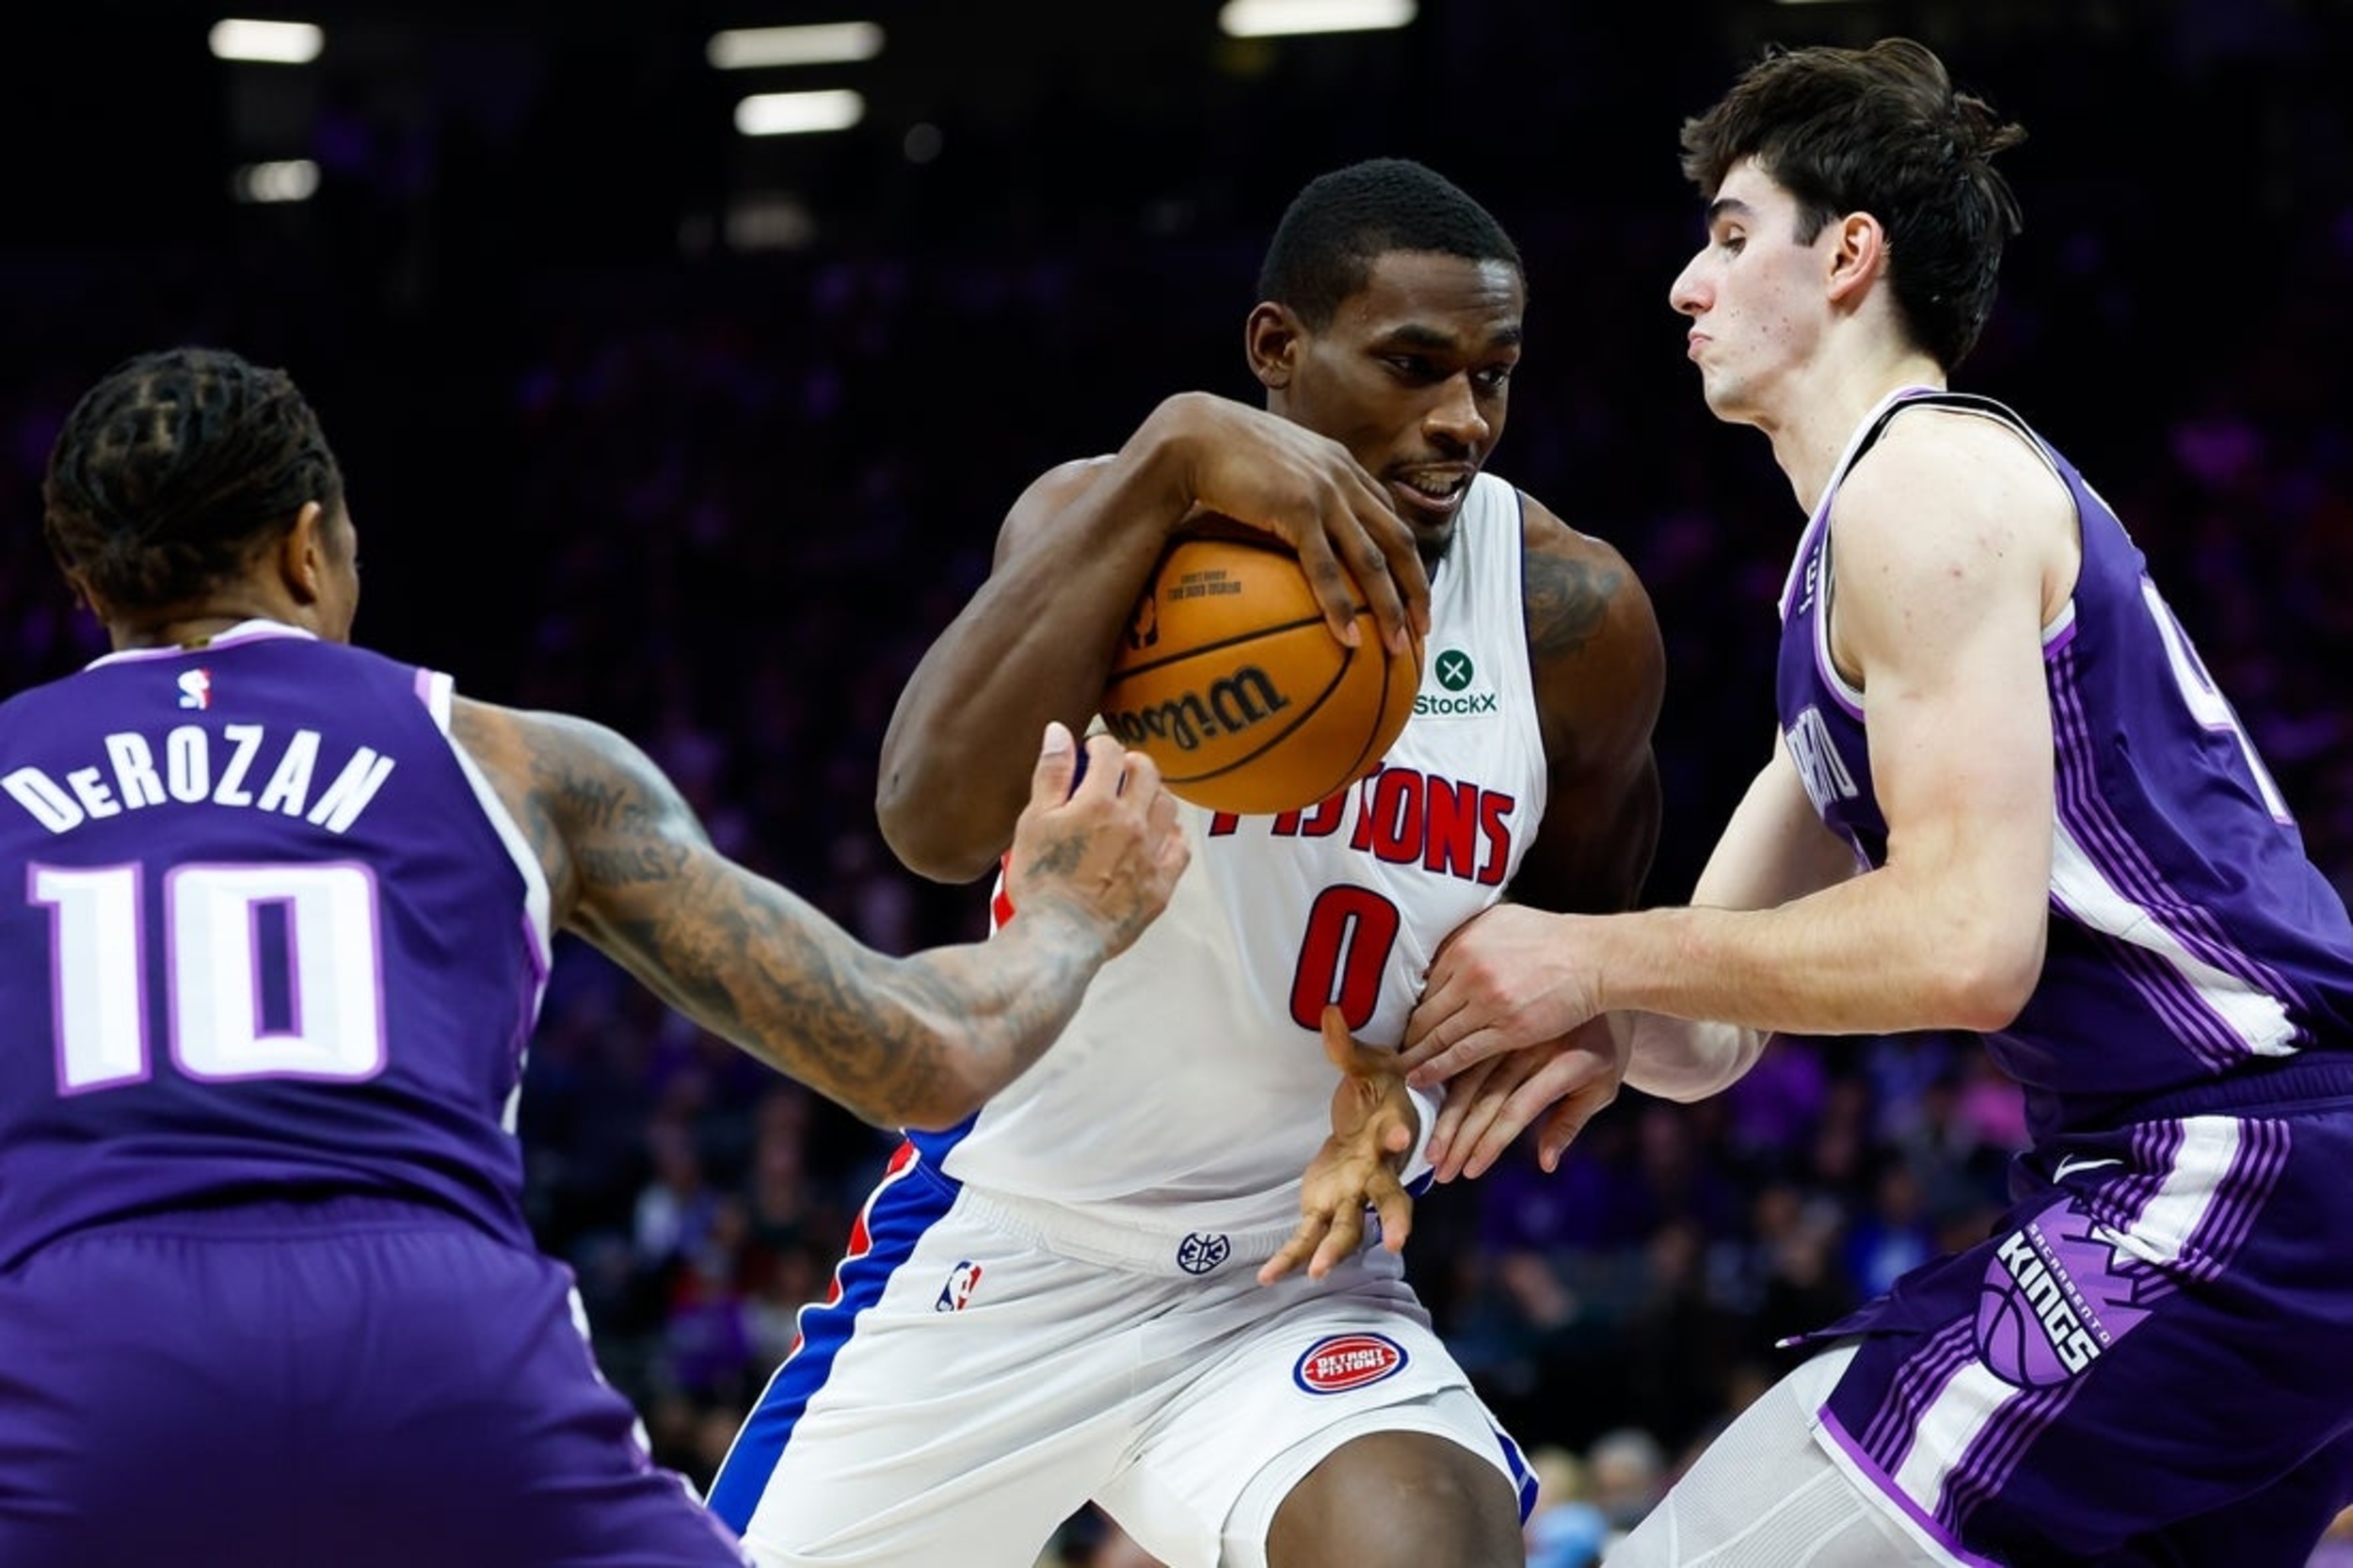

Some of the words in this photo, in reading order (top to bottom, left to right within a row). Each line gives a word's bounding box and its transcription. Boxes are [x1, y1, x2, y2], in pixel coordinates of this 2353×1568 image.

[1413, 693, 1497, 715] StockX
[26, 860, 388, 1097] 10
[1290, 884, 1400, 1032] 0
[1996, 1230, 2101, 1374] KINGS
[2026, 1223, 2111, 1343] SACRAMENTO
[1317, 1349, 1383, 1369] DETROIT
[1317, 1355, 1385, 1379] PISTONS
